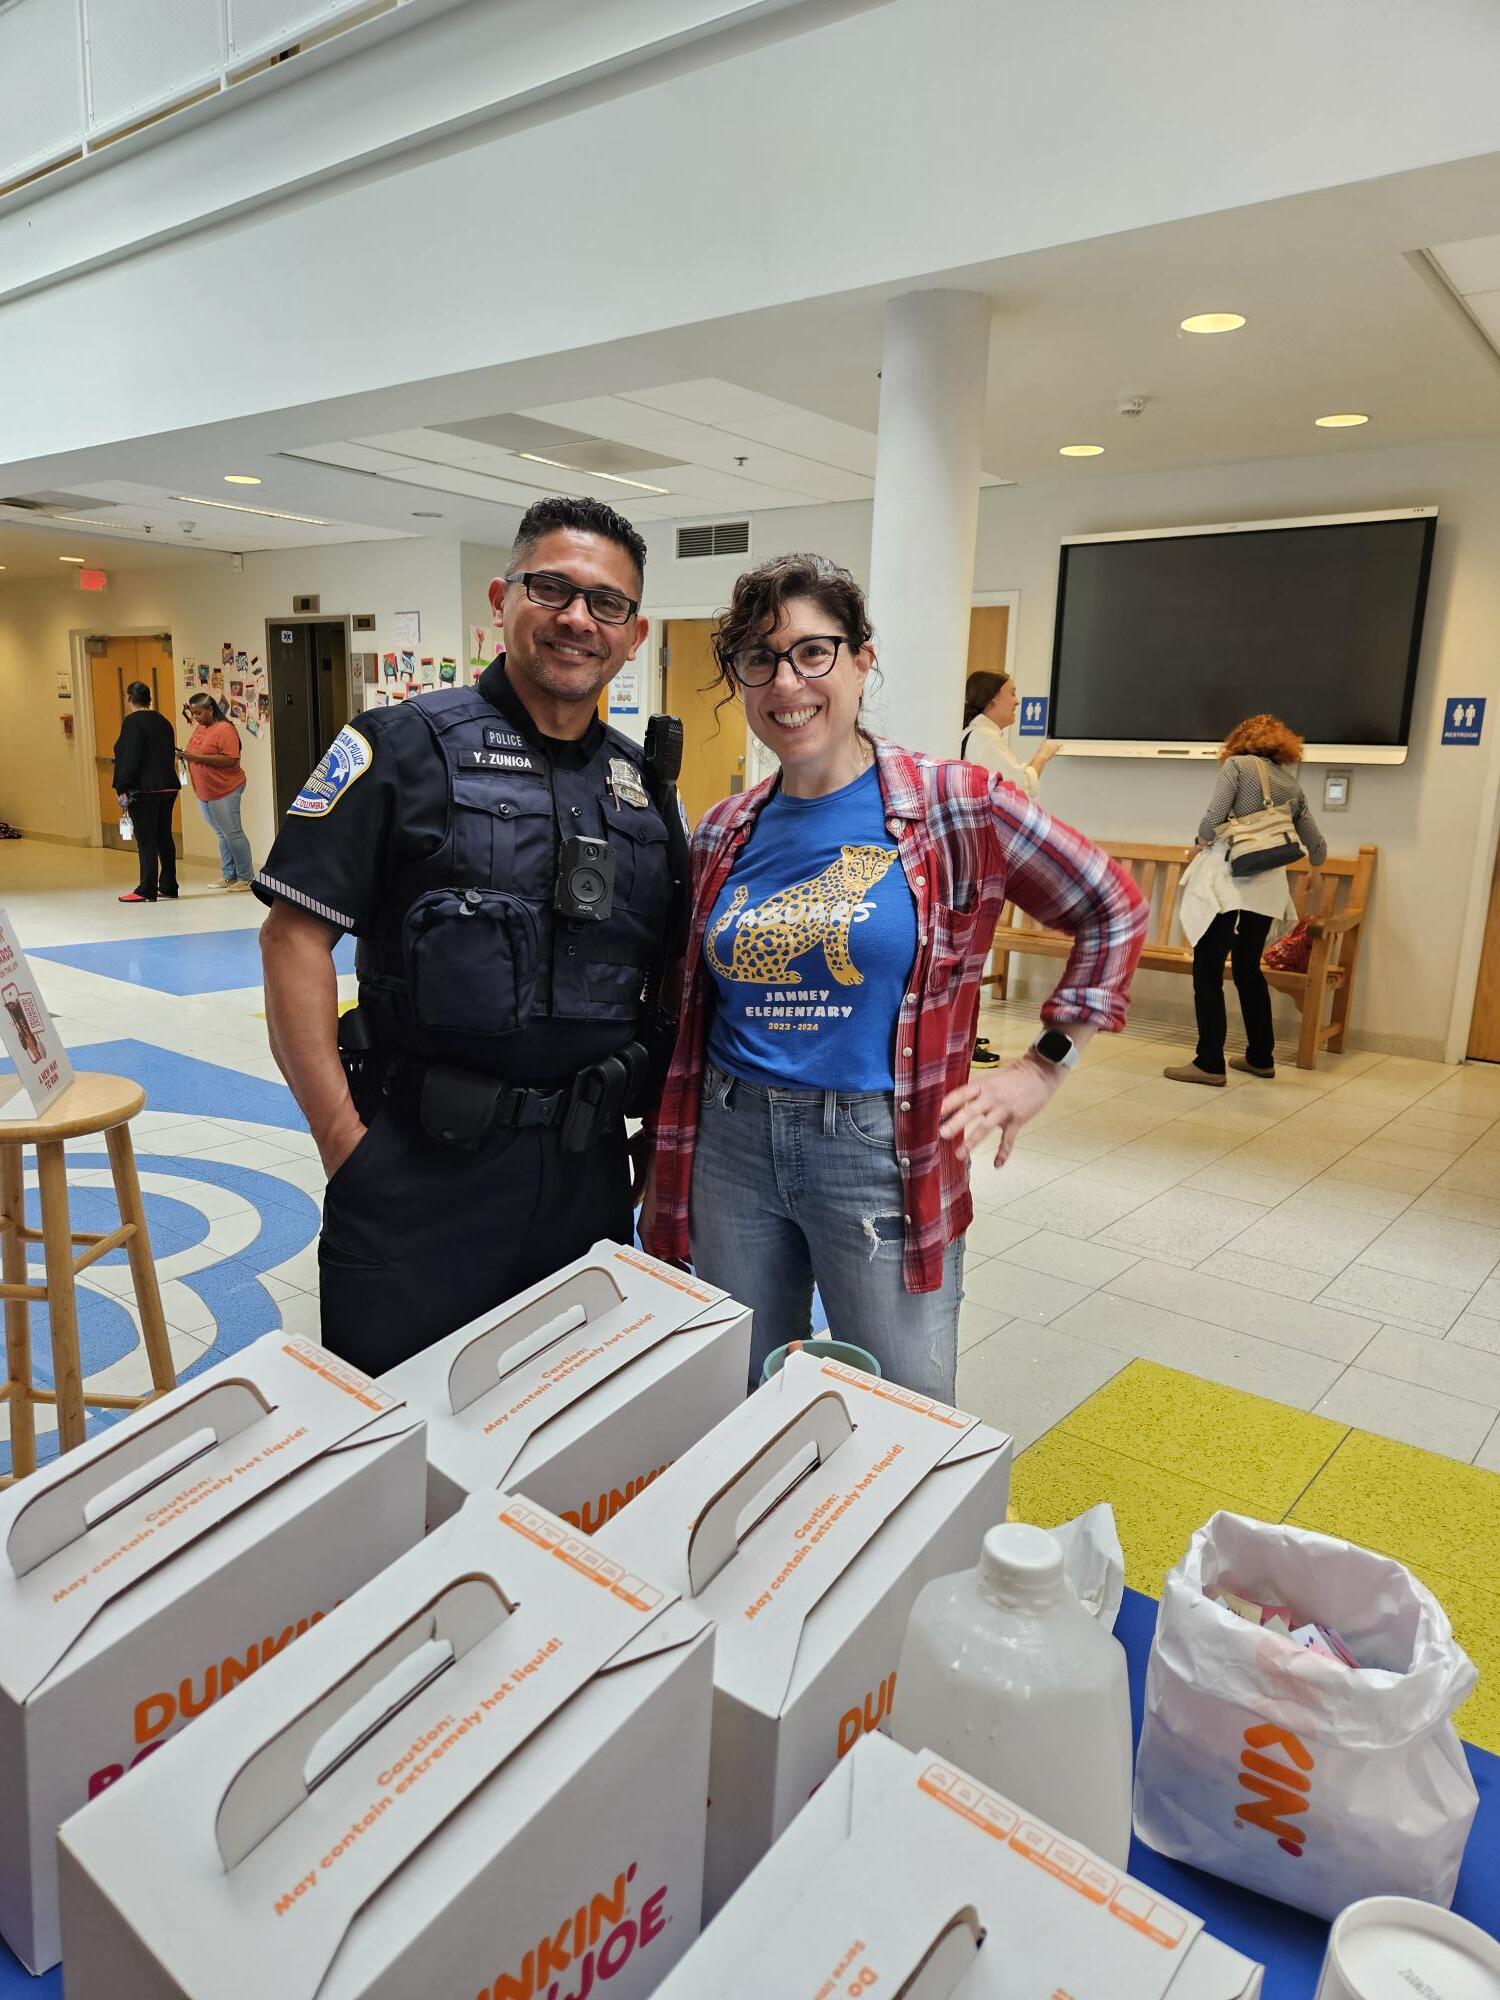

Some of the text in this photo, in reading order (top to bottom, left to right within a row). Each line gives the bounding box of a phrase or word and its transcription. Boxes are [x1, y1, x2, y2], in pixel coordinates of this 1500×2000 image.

[350, 743, 365, 766] POLICE
[489, 731, 523, 747] POLICE
[473, 751, 533, 768] Y. ZUNIGA
[745, 1006, 853, 1018] ELEMENTARY
[764, 989, 830, 1002] JANNEY
[483, 1312, 656, 1434] May contain extremely hot liquid!
[542, 1347, 590, 1380] Caution:
[52, 1427, 309, 1603] May contain extremely hot liquid!
[145, 1476, 215, 1523] Caution:
[794, 1493, 840, 1540] Caution:
[744, 1443, 906, 1621] May contain extremely hot liquid!
[376, 1714, 456, 1787] Caution:
[273, 1636, 564, 1917] May contain extremely hot liquid!
[847, 1966, 879, 1997] Do
